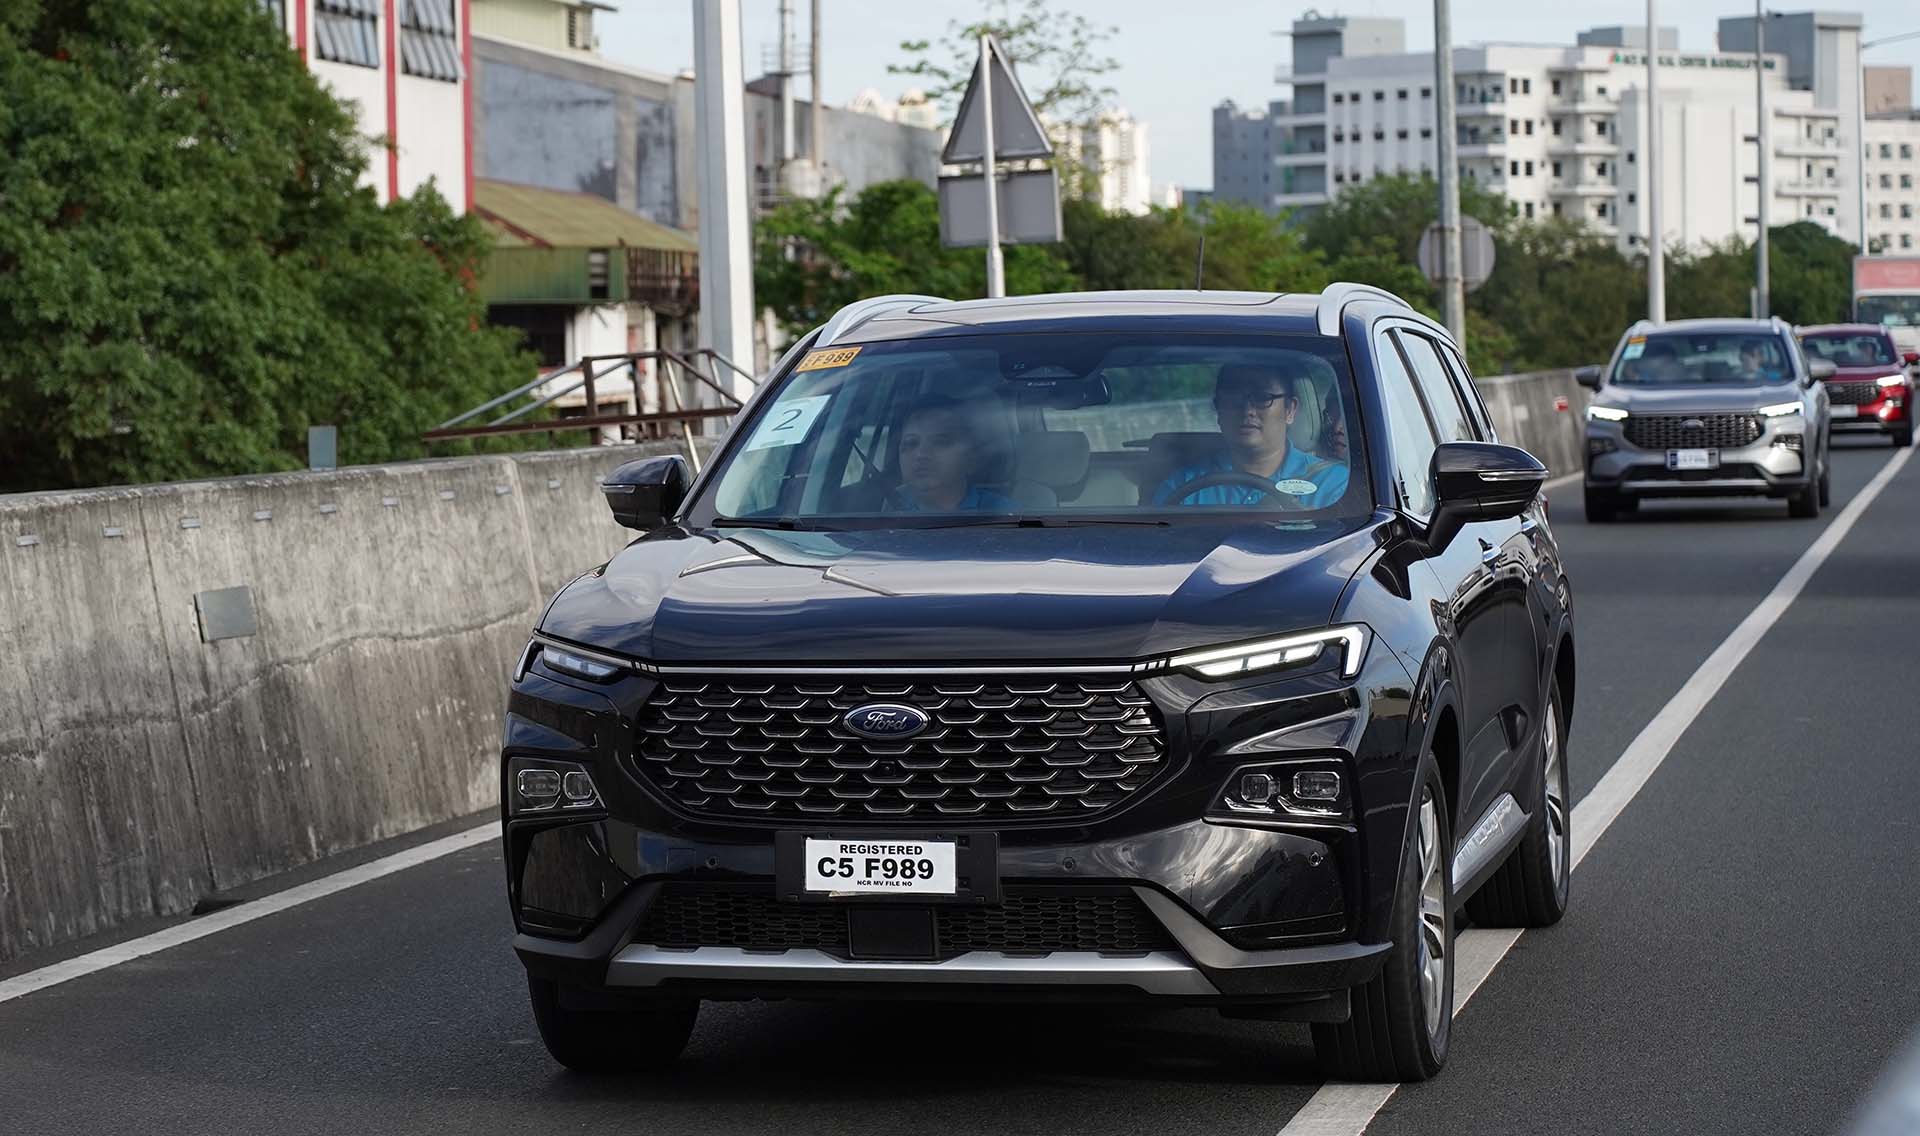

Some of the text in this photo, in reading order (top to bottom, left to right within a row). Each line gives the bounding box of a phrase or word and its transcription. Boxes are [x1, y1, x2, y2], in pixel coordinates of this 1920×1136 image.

[772, 409, 803, 432] 2
[863, 711, 908, 731] Ford
[839, 844, 923, 856] REGISTERED
[817, 857, 934, 879] C5 F989
